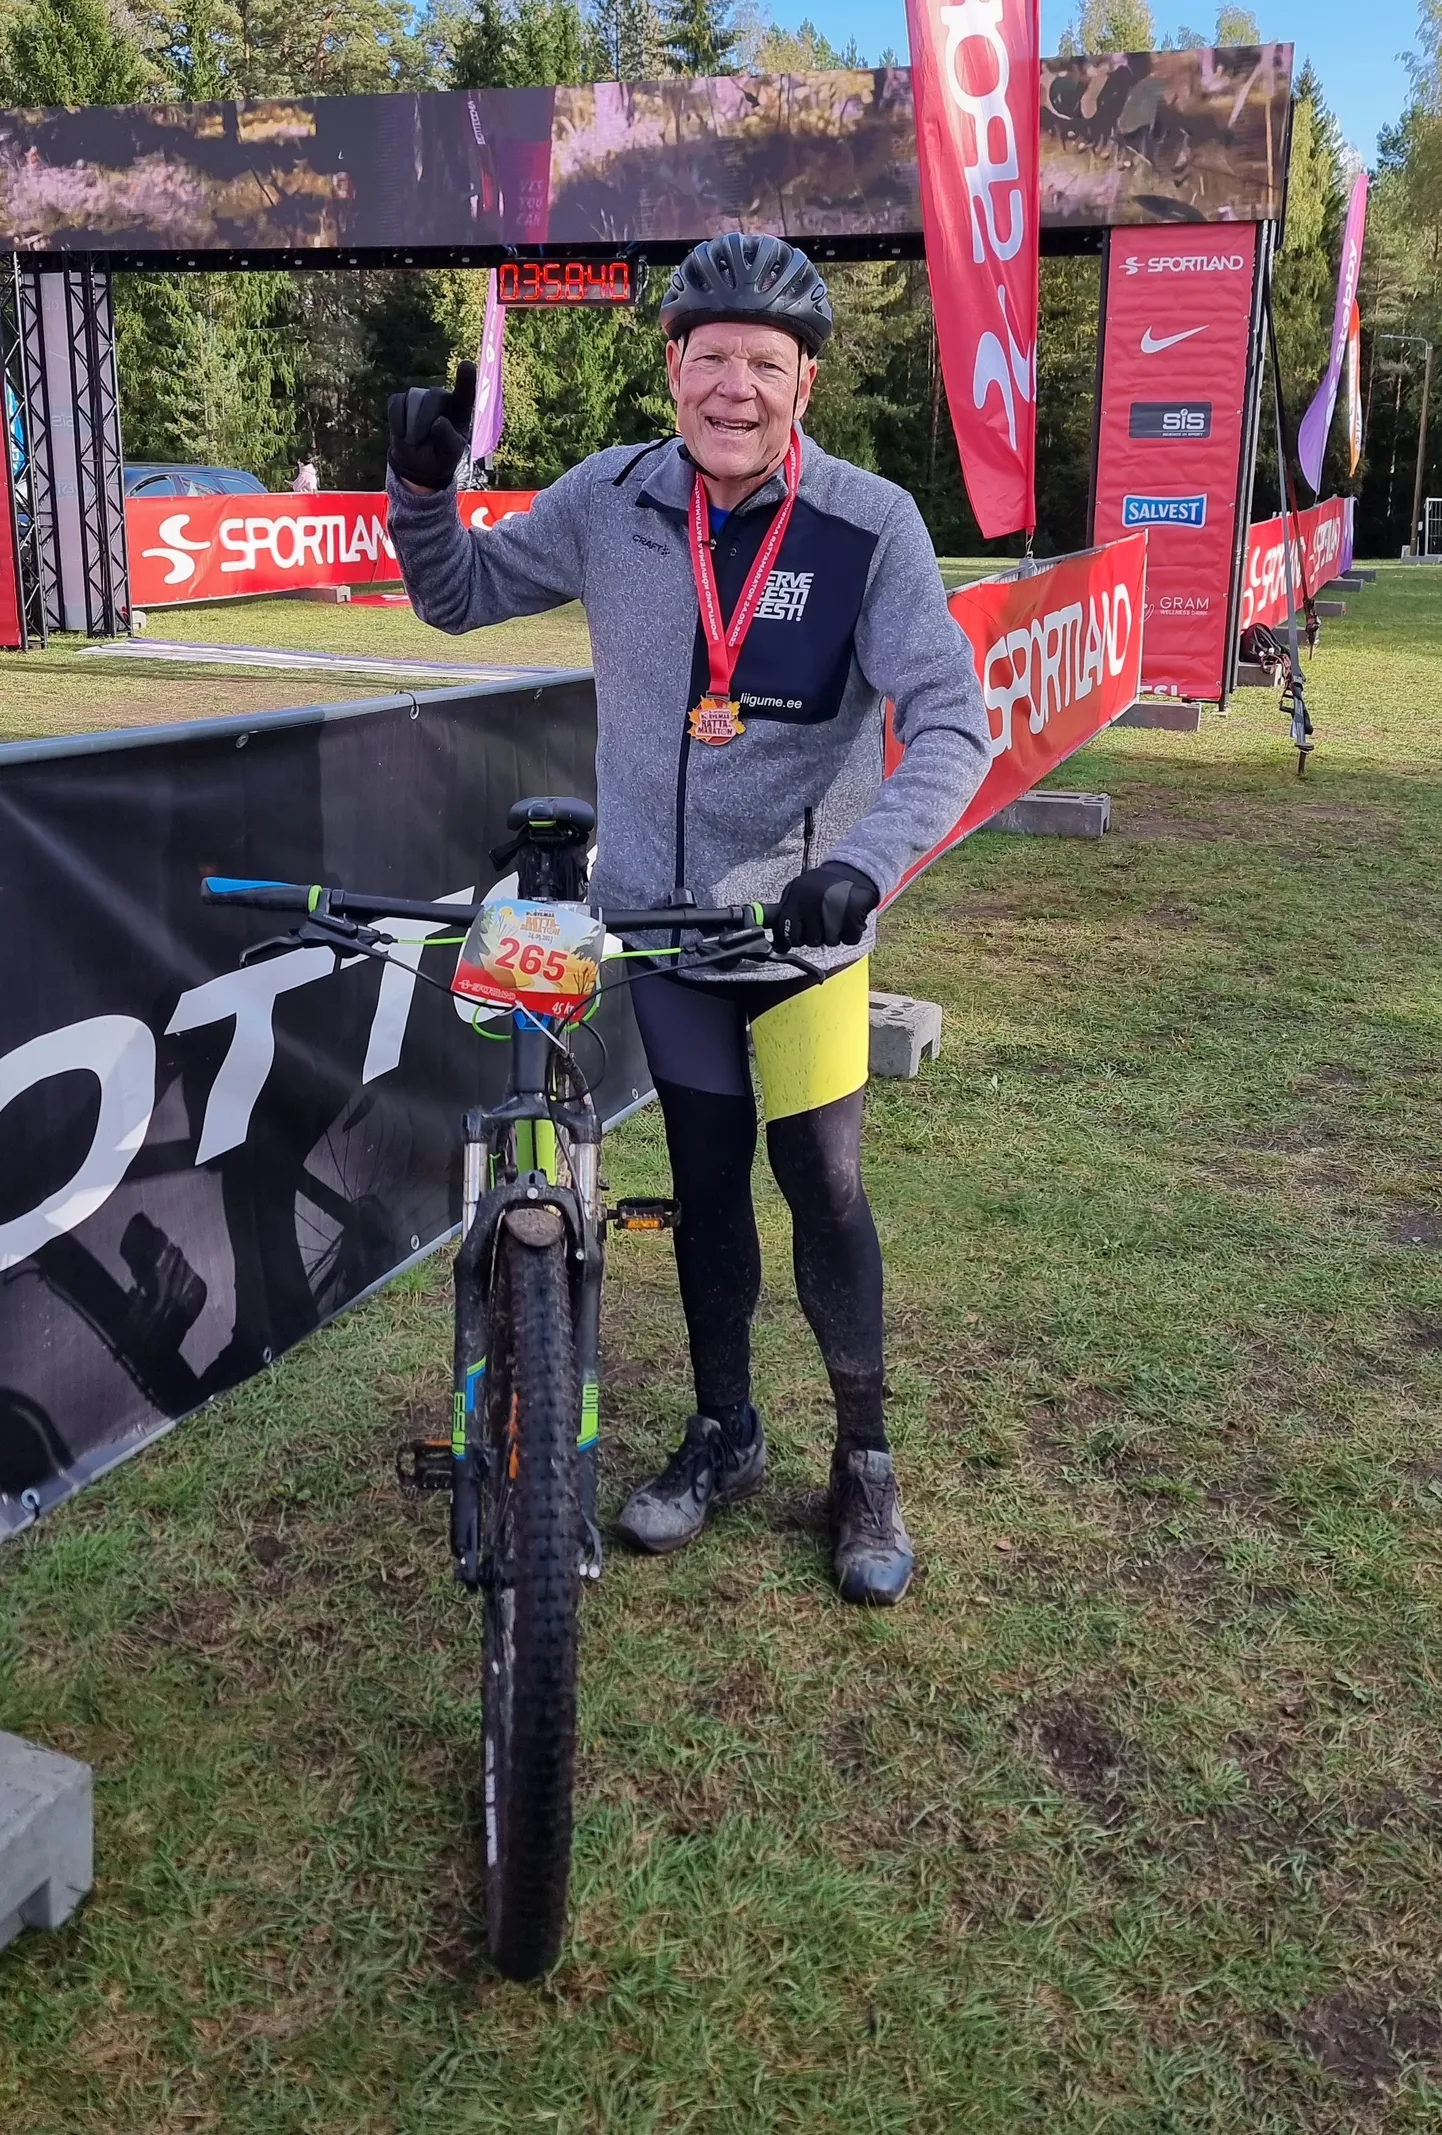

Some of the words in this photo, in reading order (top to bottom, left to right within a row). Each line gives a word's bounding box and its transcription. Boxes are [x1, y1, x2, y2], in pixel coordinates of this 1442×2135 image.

[1147, 255, 1244, 273] SPORTLAND
[1128, 502, 1200, 521] SALVEST
[219, 514, 399, 573] SPORTLAN
[632, 534, 663, 552] CRAFT
[766, 570, 814, 589] ERVE
[1160, 596, 1209, 610] GRAM
[707, 592, 719, 641] SPORTLAND
[984, 583, 1132, 759] SPORTLAND
[740, 693, 802, 709] liigume.ee
[783, 918, 791, 938] CRA
[495, 937, 568, 981] 265
[552, 1001, 564, 1015] 45
